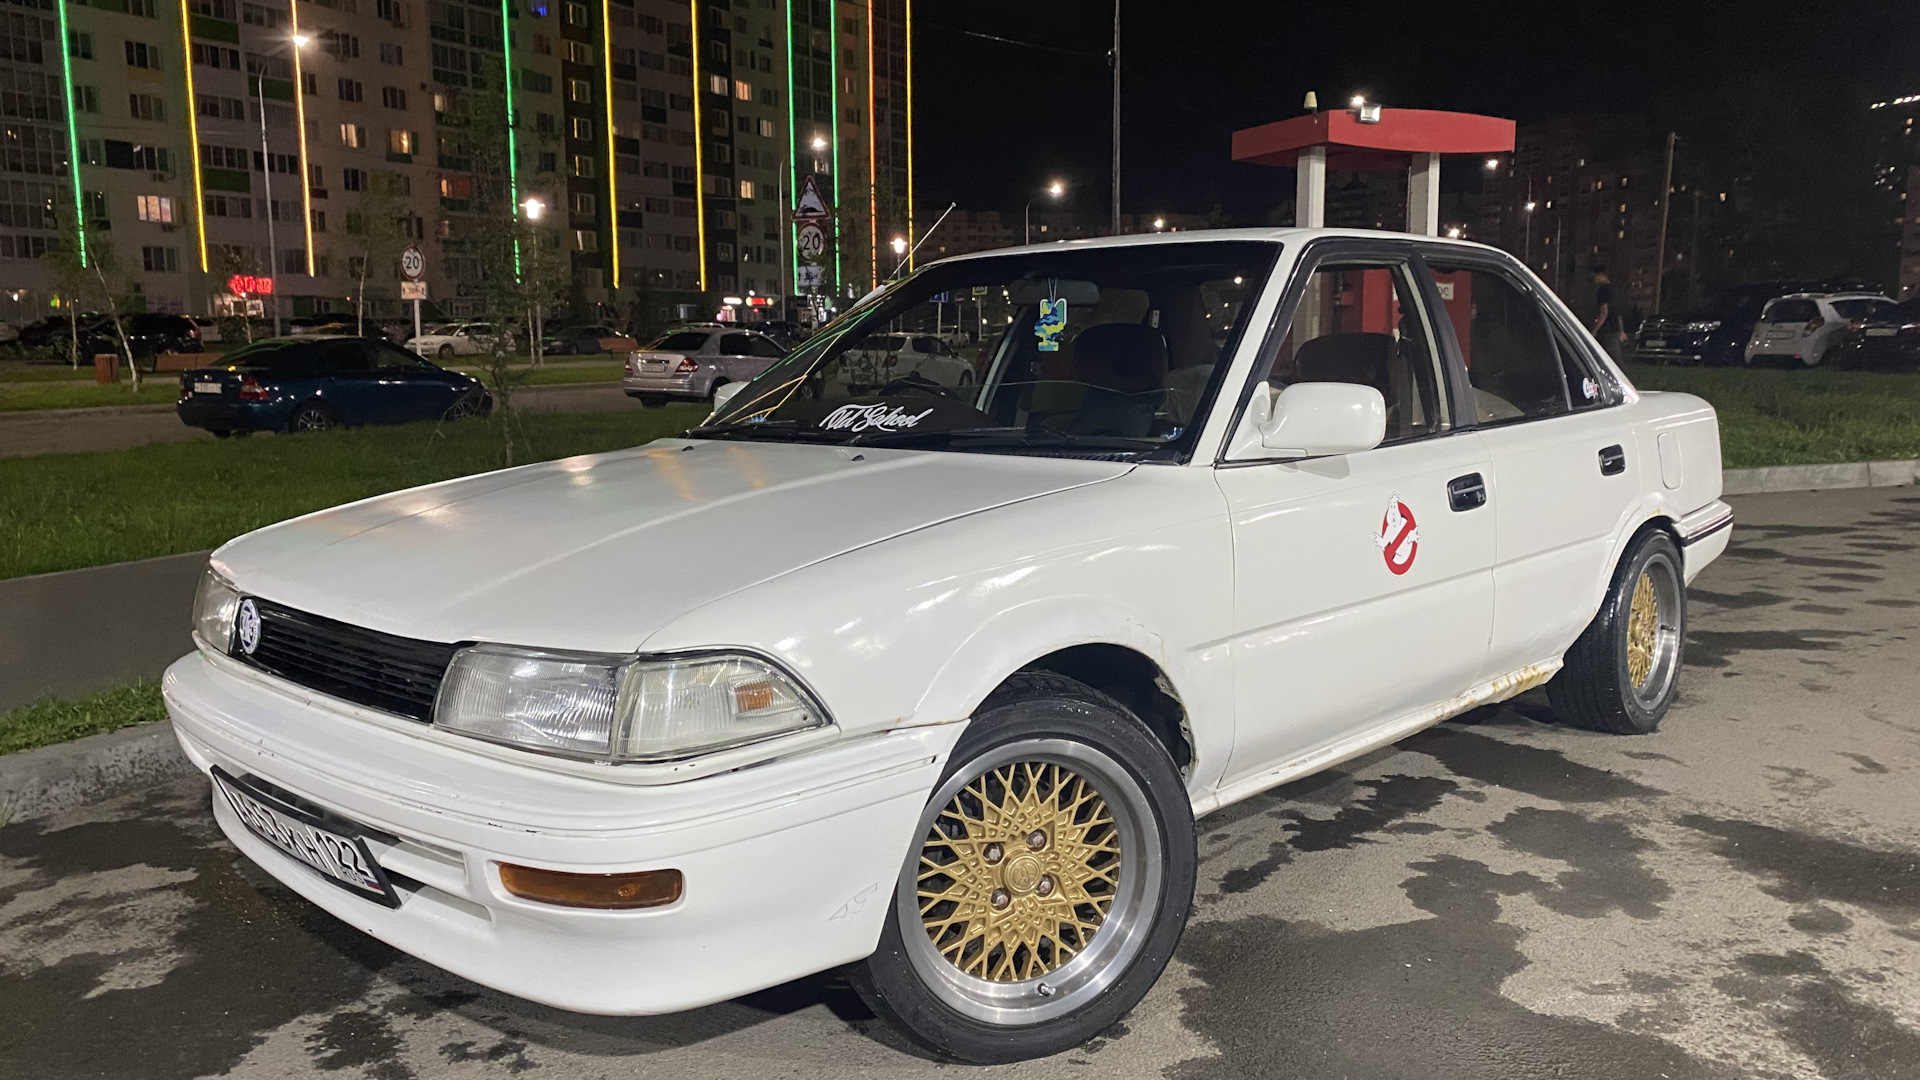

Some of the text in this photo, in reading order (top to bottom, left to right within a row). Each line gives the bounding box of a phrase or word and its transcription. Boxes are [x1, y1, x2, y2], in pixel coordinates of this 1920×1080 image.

[802, 235, 820, 250] 20
[405, 256, 419, 269] 20
[315, 830, 371, 878] 122
